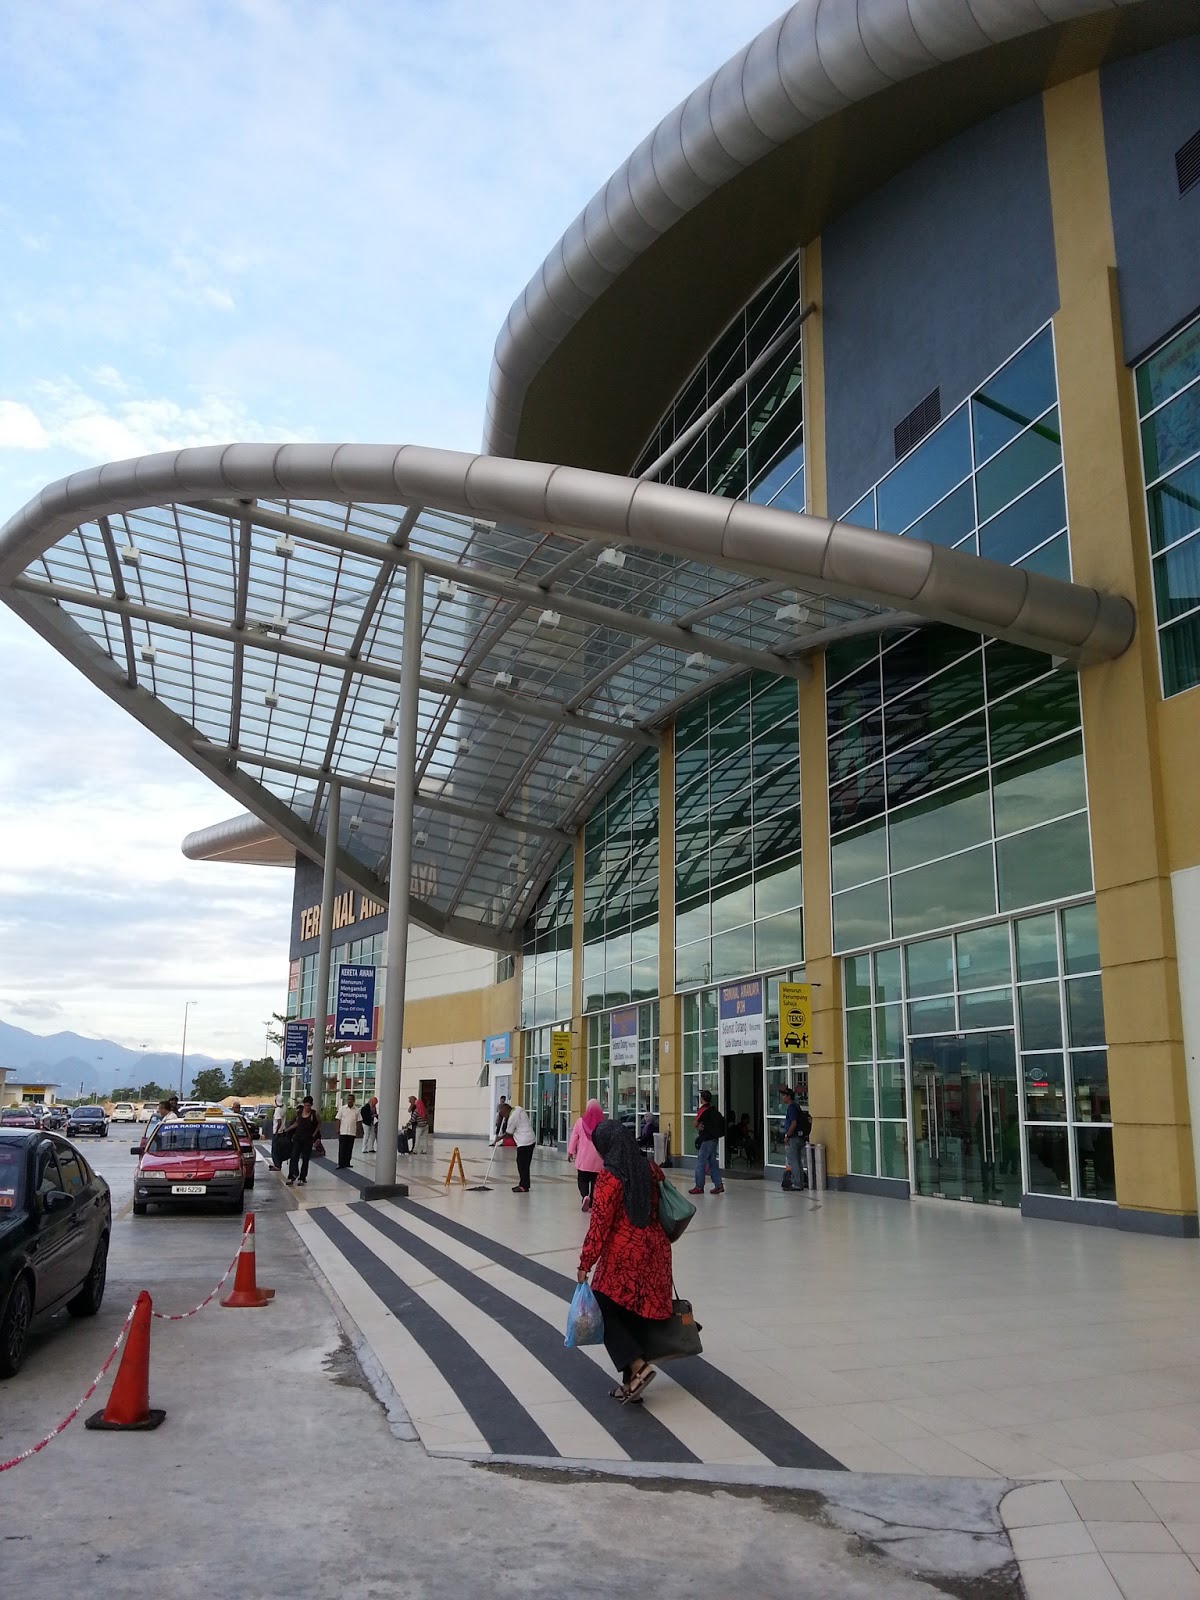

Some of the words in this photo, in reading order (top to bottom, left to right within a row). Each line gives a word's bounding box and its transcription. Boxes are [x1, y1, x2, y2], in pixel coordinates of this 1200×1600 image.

[300, 889, 355, 942] TERNAL
[341, 968, 358, 977] KERETA
[359, 969, 374, 978] AWAM
[783, 994, 808, 1002] Penumpang
[788, 1015, 804, 1023] TEKSI
